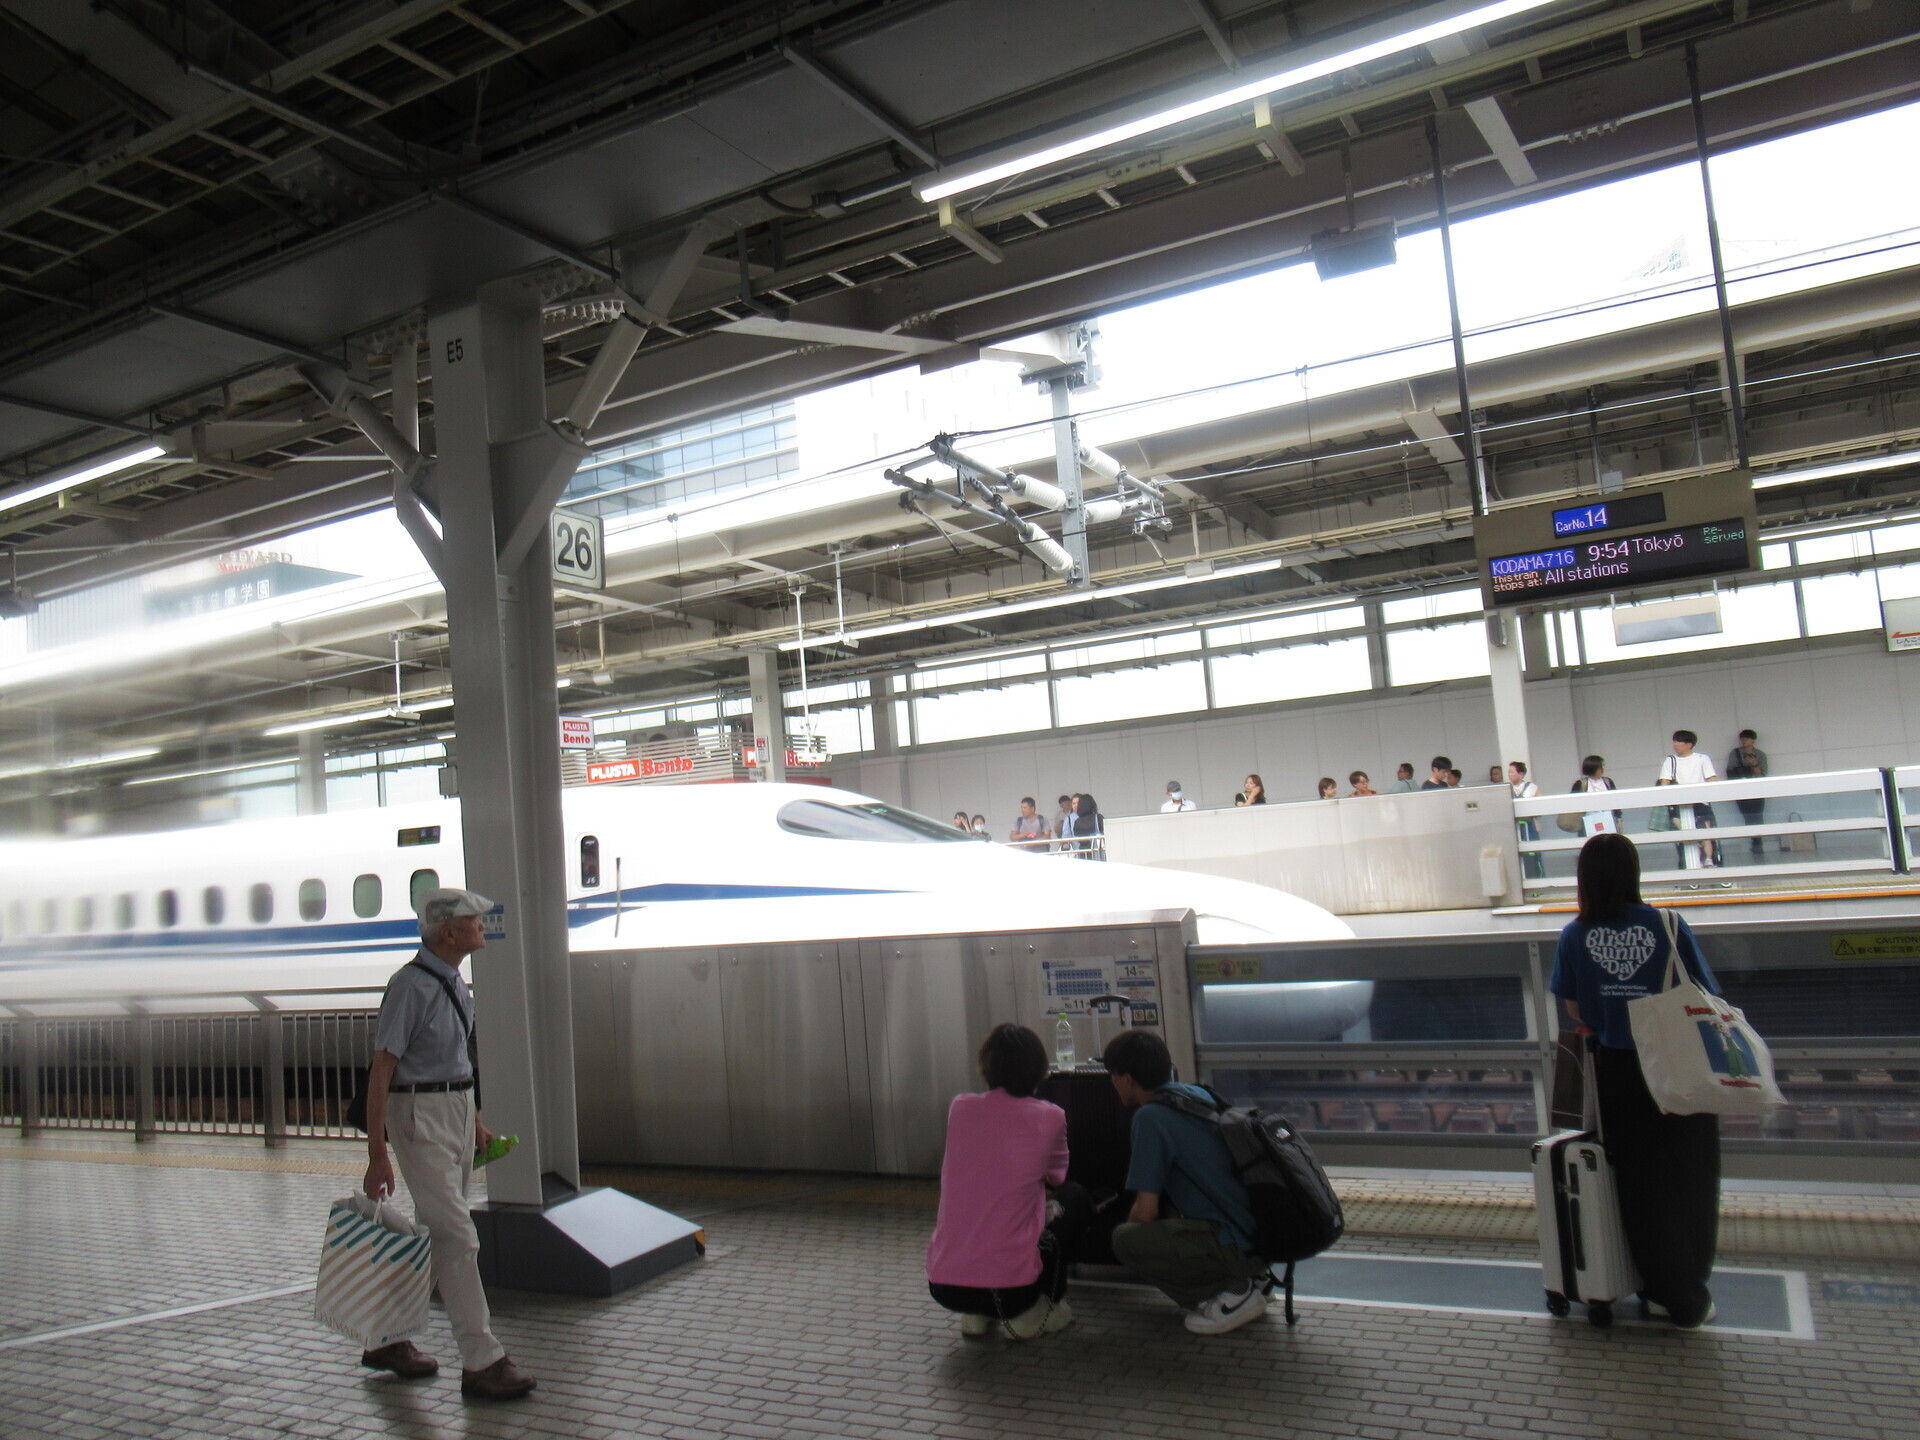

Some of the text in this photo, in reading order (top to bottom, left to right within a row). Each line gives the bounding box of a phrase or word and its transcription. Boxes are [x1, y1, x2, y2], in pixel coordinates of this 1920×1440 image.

[447, 338, 463, 363] E5
[1704, 529, 1745, 544] served
[557, 522, 592, 572] 26
[1588, 541, 1630, 562] 9:54
[1632, 534, 1684, 553] Tōkyō
[1514, 571, 1539, 582] train
[1545, 562, 1629, 584] All stations
[1494, 577, 1543, 592] stops at:
[564, 722, 588, 731] PLUSTA
[563, 733, 590, 744] Bento
[591, 756, 695, 780] PLUSTA Bento
[1125, 966, 1137, 977] 14
[1601, 959, 1641, 981] Day
